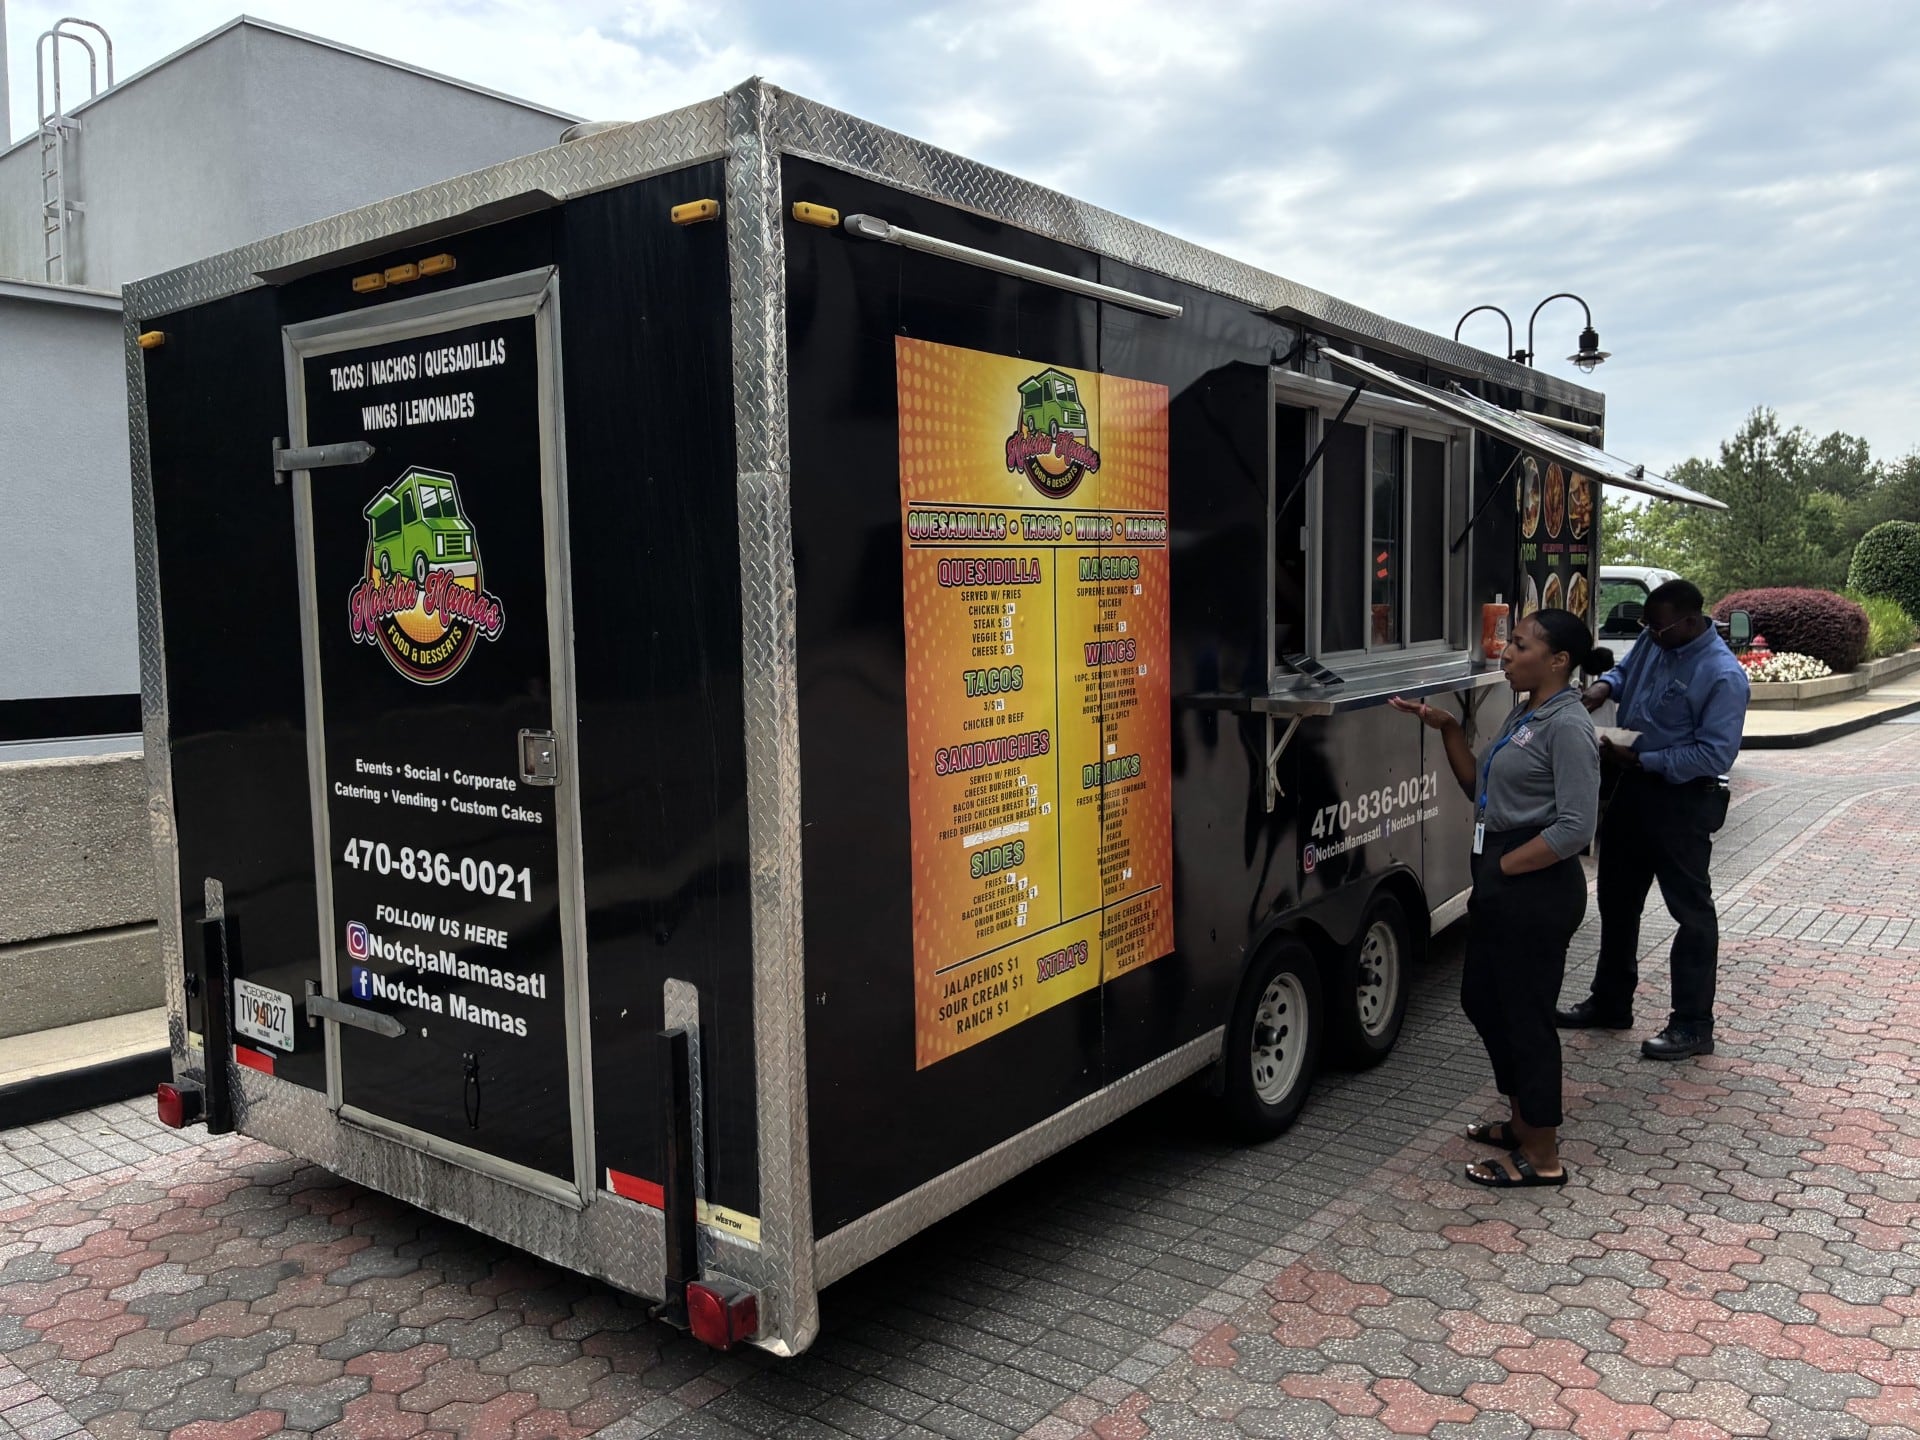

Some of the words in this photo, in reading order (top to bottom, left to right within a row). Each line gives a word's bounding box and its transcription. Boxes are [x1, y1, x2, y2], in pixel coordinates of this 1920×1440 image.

[331, 364, 365, 392] TACOS
[372, 356, 416, 384] NACHOS
[424, 337, 506, 378] QUESADILLAS
[362, 403, 397, 431] WINGS
[405, 392, 475, 425] LEMONADES
[1032, 463, 1046, 483] FOOD
[1052, 466, 1078, 488] DESSERTS
[907, 511, 1006, 540] QUESADILLAS
[1021, 515, 1062, 541] TACOS
[1075, 516, 1113, 540] WINGS
[1124, 518, 1167, 541] NACHOS
[938, 558, 1041, 586] QUESIDILLA
[1079, 556, 1139, 581] NACHOS
[352, 572, 418, 635] Notcha
[424, 569, 500, 631] Mamas
[961, 591, 988, 601] SERVED
[991, 590, 1000, 601] W/
[1003, 589, 1022, 600] FRIES
[1076, 586, 1105, 597] SUPREME
[1106, 585, 1128, 595] NACHOS
[1098, 598, 1122, 608] CHICKEN
[968, 605, 999, 616] CHICKEN
[974, 618, 996, 629] STEAK
[388, 625, 409, 657] FOOD
[411, 648, 418, 661] &
[420, 626, 462, 665] DESSERTS
[972, 632, 997, 643] VEGGIE
[972, 646, 998, 657] CHEESE
[1084, 638, 1137, 667] WINGS
[963, 665, 1023, 697] TACOS
[1120, 667, 1134, 676] FRIES
[1086, 683, 1096, 692] HOT
[1117, 677, 1135, 686] PEPPER
[1119, 688, 1136, 697] PEPPER
[1120, 698, 1138, 708] PEPPER
[963, 718, 994, 731] CHICKEN
[997, 715, 1006, 725] OR
[1008, 712, 1025, 723] BEEF
[935, 730, 1050, 776] SANDWICHES
[356, 758, 393, 777] Events
[404, 764, 441, 783] Social
[453, 770, 517, 791] Corporate
[969, 773, 992, 786] SERVED
[1004, 766, 1021, 778] FRIES
[1082, 754, 1141, 789] DRINKS
[953, 802, 975, 813] BACON
[976, 795, 998, 807] CHEESE
[1000, 789, 1023, 801] BURGER
[965, 787, 987, 798] CHEESE
[989, 780, 1013, 792] BURGER
[1076, 795, 1093, 807] FRESH
[335, 781, 381, 804] Catering
[392, 790, 438, 812] Vending
[450, 797, 498, 818] Custom
[501, 803, 543, 824] Cakes
[953, 814, 972, 825] FRIED
[974, 806, 1000, 820] CHICKEN
[1002, 800, 1024, 811] BREAST
[1311, 770, 1437, 840] 470-836-0021
[939, 829, 958, 841] FRIED
[960, 821, 987, 835] BUFFALO
[988, 814, 1014, 827] CHICKEN
[1016, 807, 1037, 820] BREAST
[1315, 824, 1381, 864] NotchaMamasatl
[1391, 814, 1415, 833] Notcha
[1416, 805, 1439, 823] Mamas
[344, 837, 532, 903] 470-836-0021
[970, 840, 1025, 879] SIDES
[973, 890, 996, 905] CHEESE
[997, 884, 1014, 897] FRIES
[985, 876, 1002, 890] FRIES
[961, 906, 983, 921] BACON
[985, 899, 1007, 913] CHEESE
[1008, 892, 1025, 905] FRIES
[974, 914, 994, 928] ONION
[995, 907, 1014, 920] RINGS
[1107, 911, 1121, 925] BLUE
[1122, 902, 1143, 918] CHEESE
[376, 904, 435, 933] FOLLOW
[439, 917, 460, 938] US
[464, 923, 508, 950] HERE
[976, 926, 994, 939] FRIED
[996, 920, 1012, 931] OKRA
[1099, 921, 1128, 940] SHREDDED
[1130, 911, 1152, 927] CHEESE
[1105, 936, 1124, 951] LIQUID
[1126, 925, 1146, 941] CHEESE
[1037, 939, 1088, 983] XTRA'S
[1116, 942, 1135, 958] BACON
[1118, 954, 1136, 969] SALSA
[369, 933, 546, 999] NotchaMamasatl
[944, 962, 1004, 999] JALAPENOS
[1007, 956, 1019, 973] $1
[372, 973, 443, 1014] Notcha
[450, 993, 528, 1038] Mamas
[939, 997, 968, 1022] SOUR
[972, 980, 1008, 1007] CREAM
[1012, 974, 1024, 990] $1
[957, 1008, 993, 1034] RANCH
[997, 1000, 1009, 1017] $1
[715, 1212, 742, 1230] WESTON
